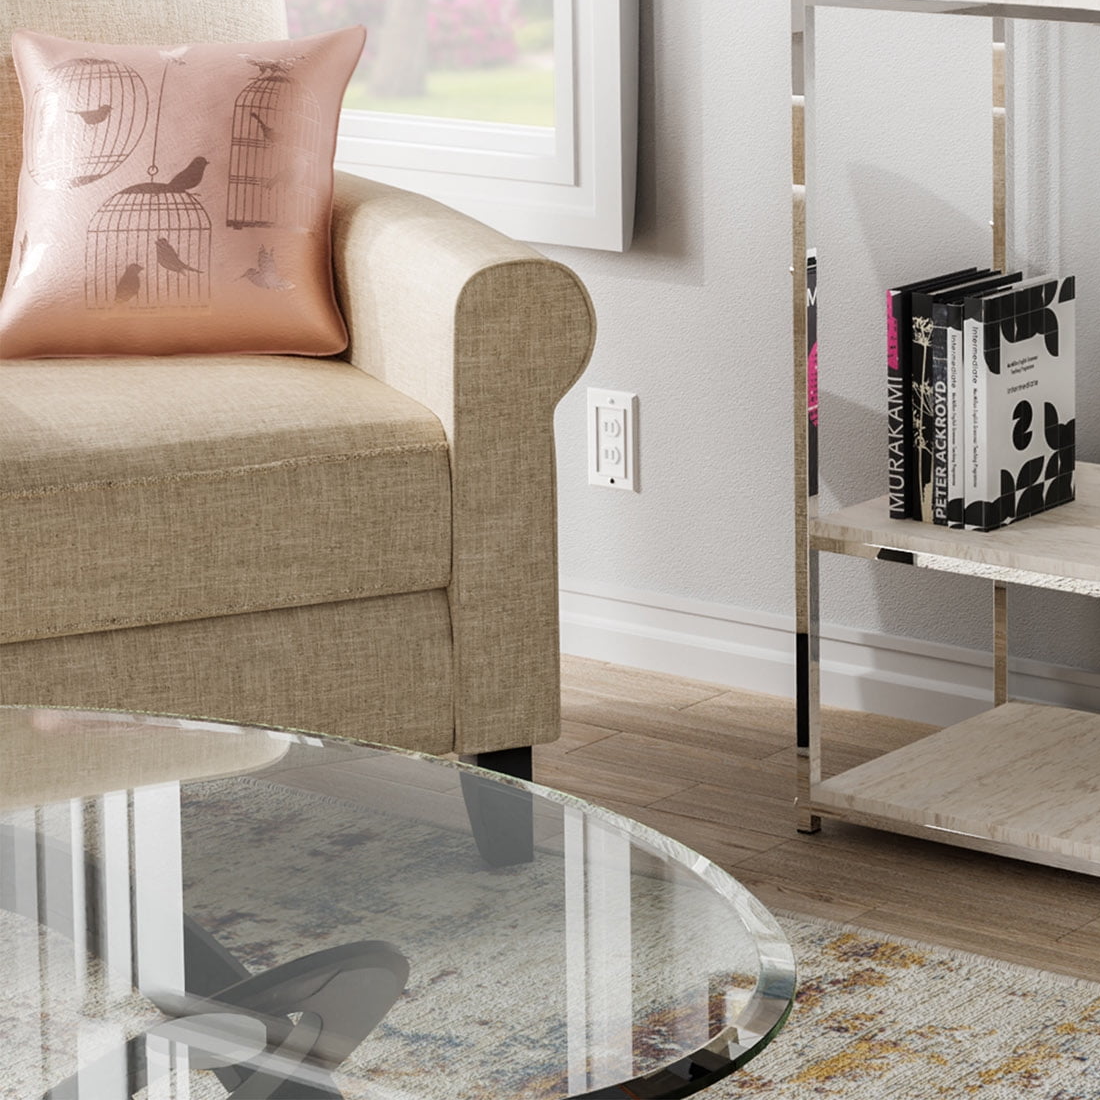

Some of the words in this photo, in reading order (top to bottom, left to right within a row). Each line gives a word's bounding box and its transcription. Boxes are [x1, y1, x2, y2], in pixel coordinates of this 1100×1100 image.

[950, 334, 958, 389] Intermediate
[972, 326, 980, 384] Intermediate
[888, 376, 905, 513] MURAKAMI
[934, 381, 947, 463] ACKROYD
[934, 467, 947, 519] PETER
